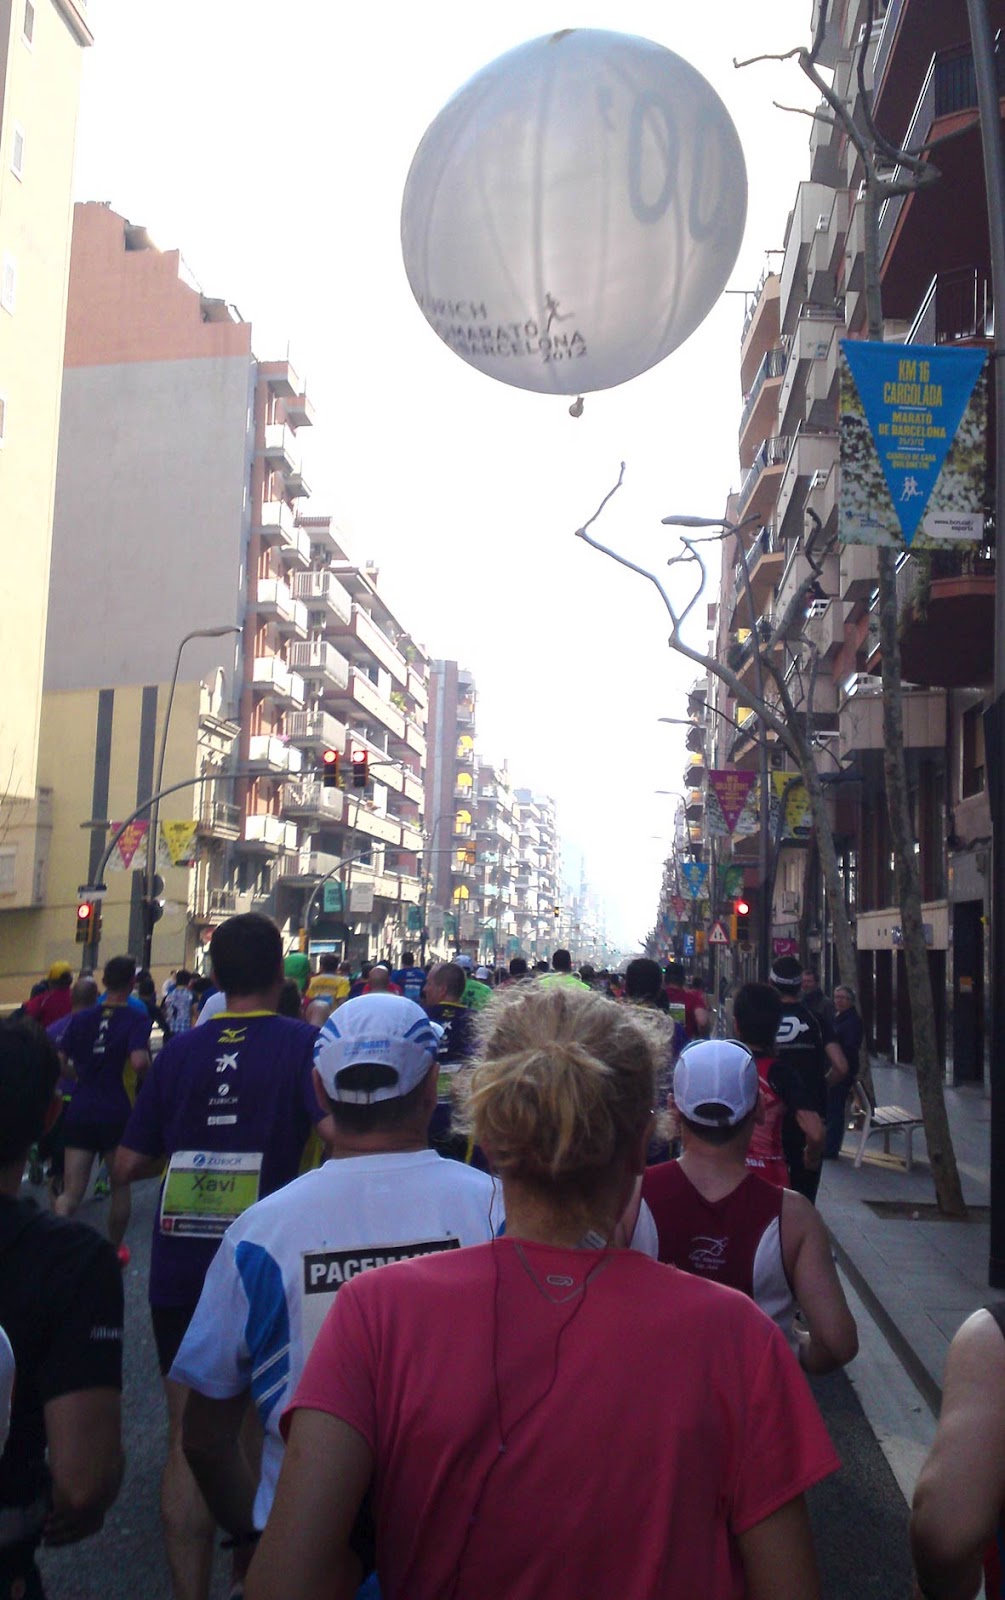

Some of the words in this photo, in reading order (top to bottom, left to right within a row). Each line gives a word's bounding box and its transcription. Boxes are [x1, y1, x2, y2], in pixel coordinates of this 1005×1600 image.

[898, 360, 916, 381] KM
[919, 361, 930, 383] 16
[883, 382, 942, 406] CARGOLADA
[879, 423, 889, 435] DE
[891, 424, 946, 438] BARCELONA
[208, 1097, 239, 1106] ZURICH
[191, 1173, 236, 1193] Xavi
